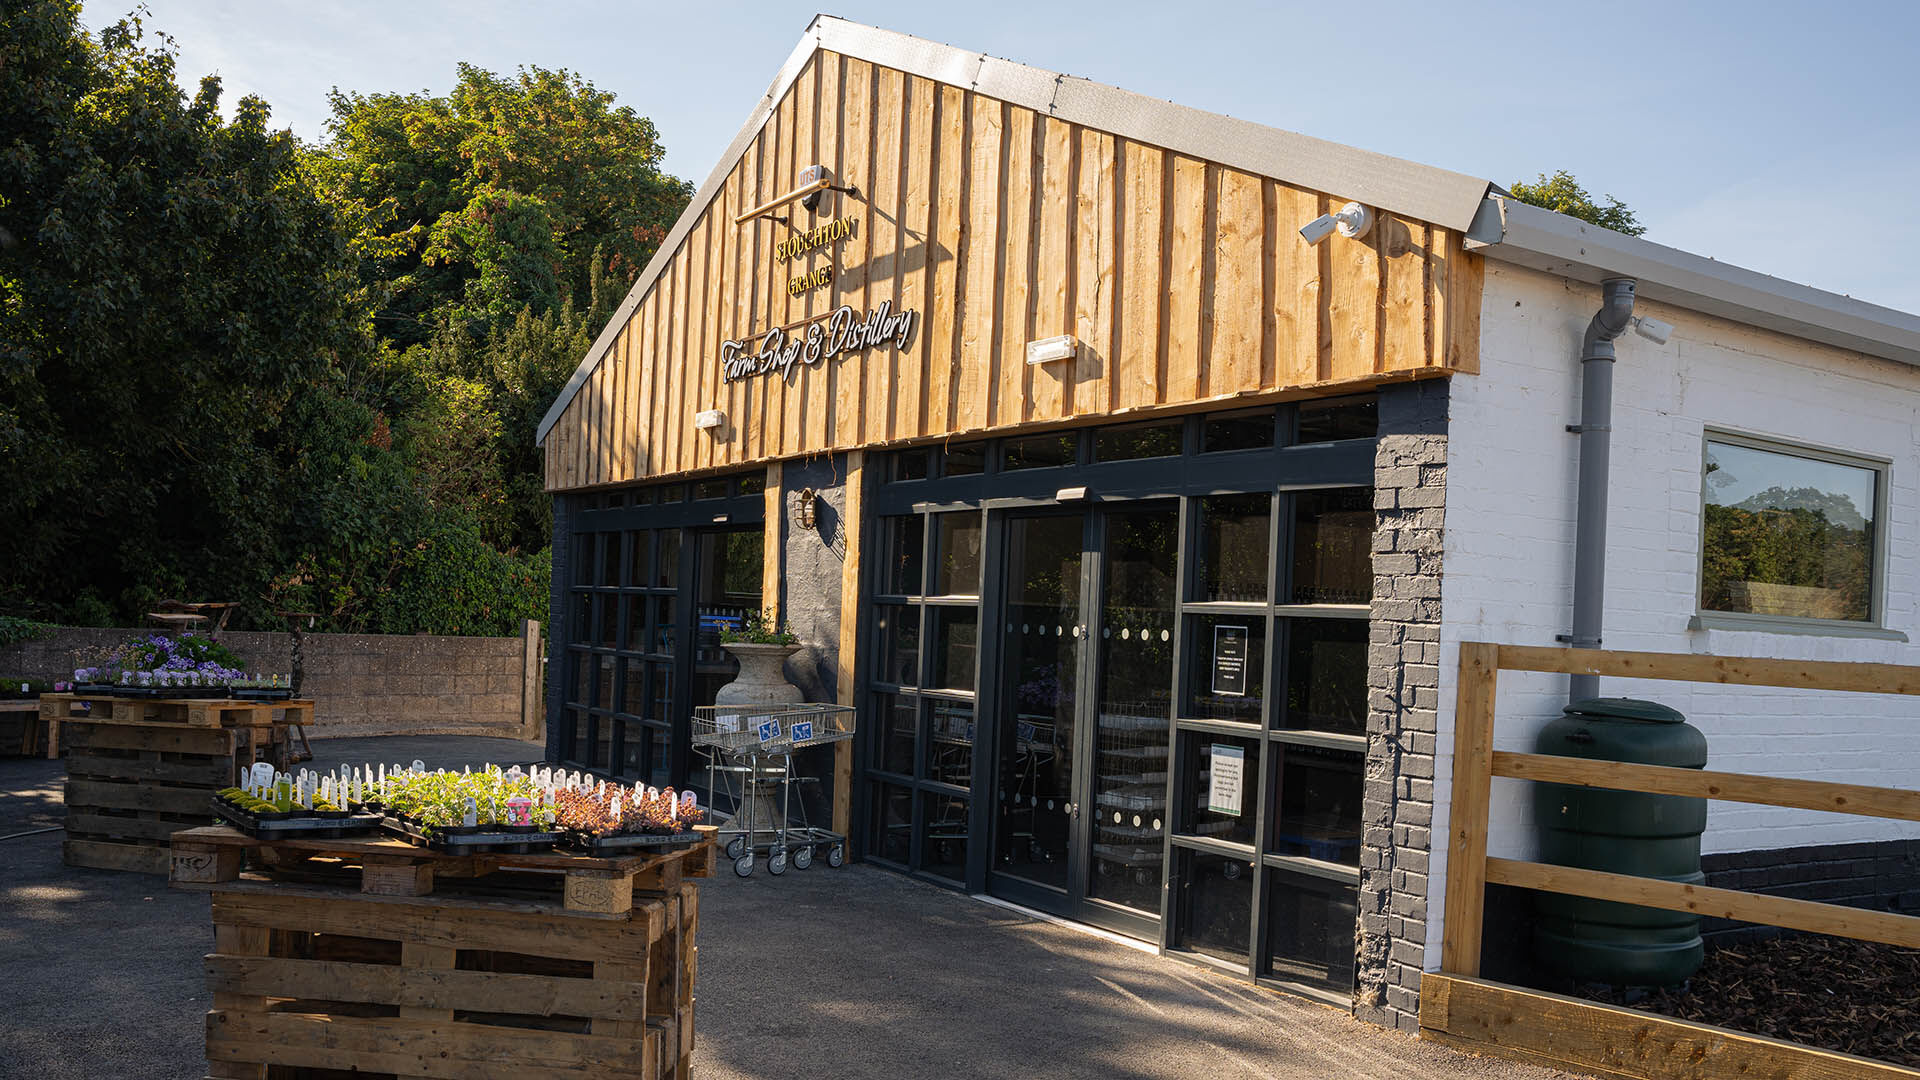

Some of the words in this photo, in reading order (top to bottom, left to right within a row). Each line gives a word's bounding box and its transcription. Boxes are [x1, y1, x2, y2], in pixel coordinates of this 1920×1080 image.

[776, 216, 851, 261] STOUGHTON
[721, 340, 758, 384] Farm
[759, 327, 804, 382] Shop
[804, 323, 825, 365] &
[824, 300, 913, 359] Distillery
